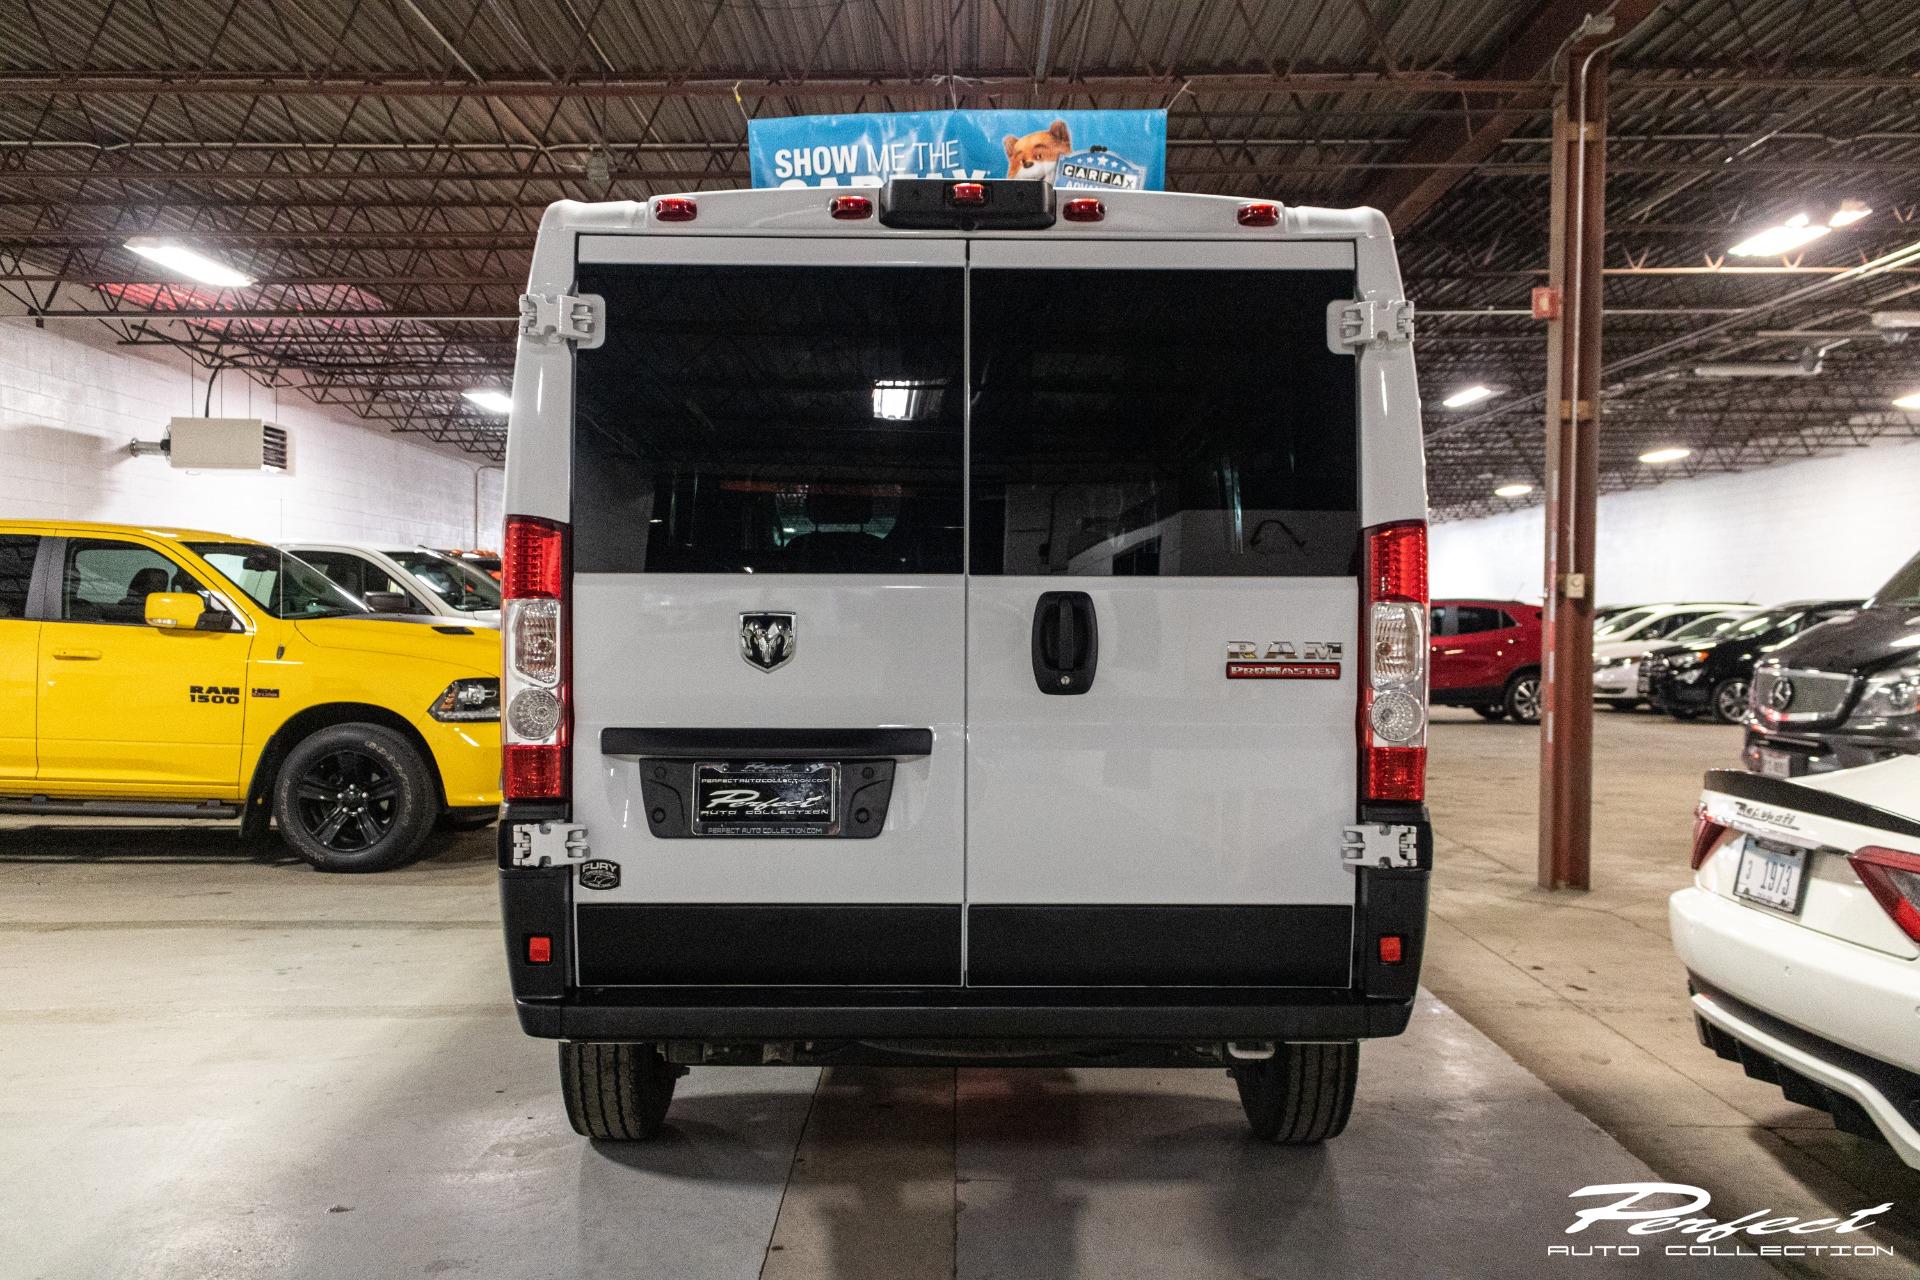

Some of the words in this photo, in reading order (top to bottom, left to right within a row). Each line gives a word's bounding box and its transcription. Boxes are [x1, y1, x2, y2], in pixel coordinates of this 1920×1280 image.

[774, 145, 858, 178] SHOW
[867, 143, 906, 173] ME
[913, 140, 960, 170] THE
[1063, 164, 1137, 189] CARFAX
[1226, 641, 1343, 660] RAM
[190, 685, 240, 695] RAM
[190, 694, 240, 704] 1500
[706, 789, 825, 811] Perfect
[582, 862, 617, 873] FURY
[1761, 860, 1793, 896] 1973
